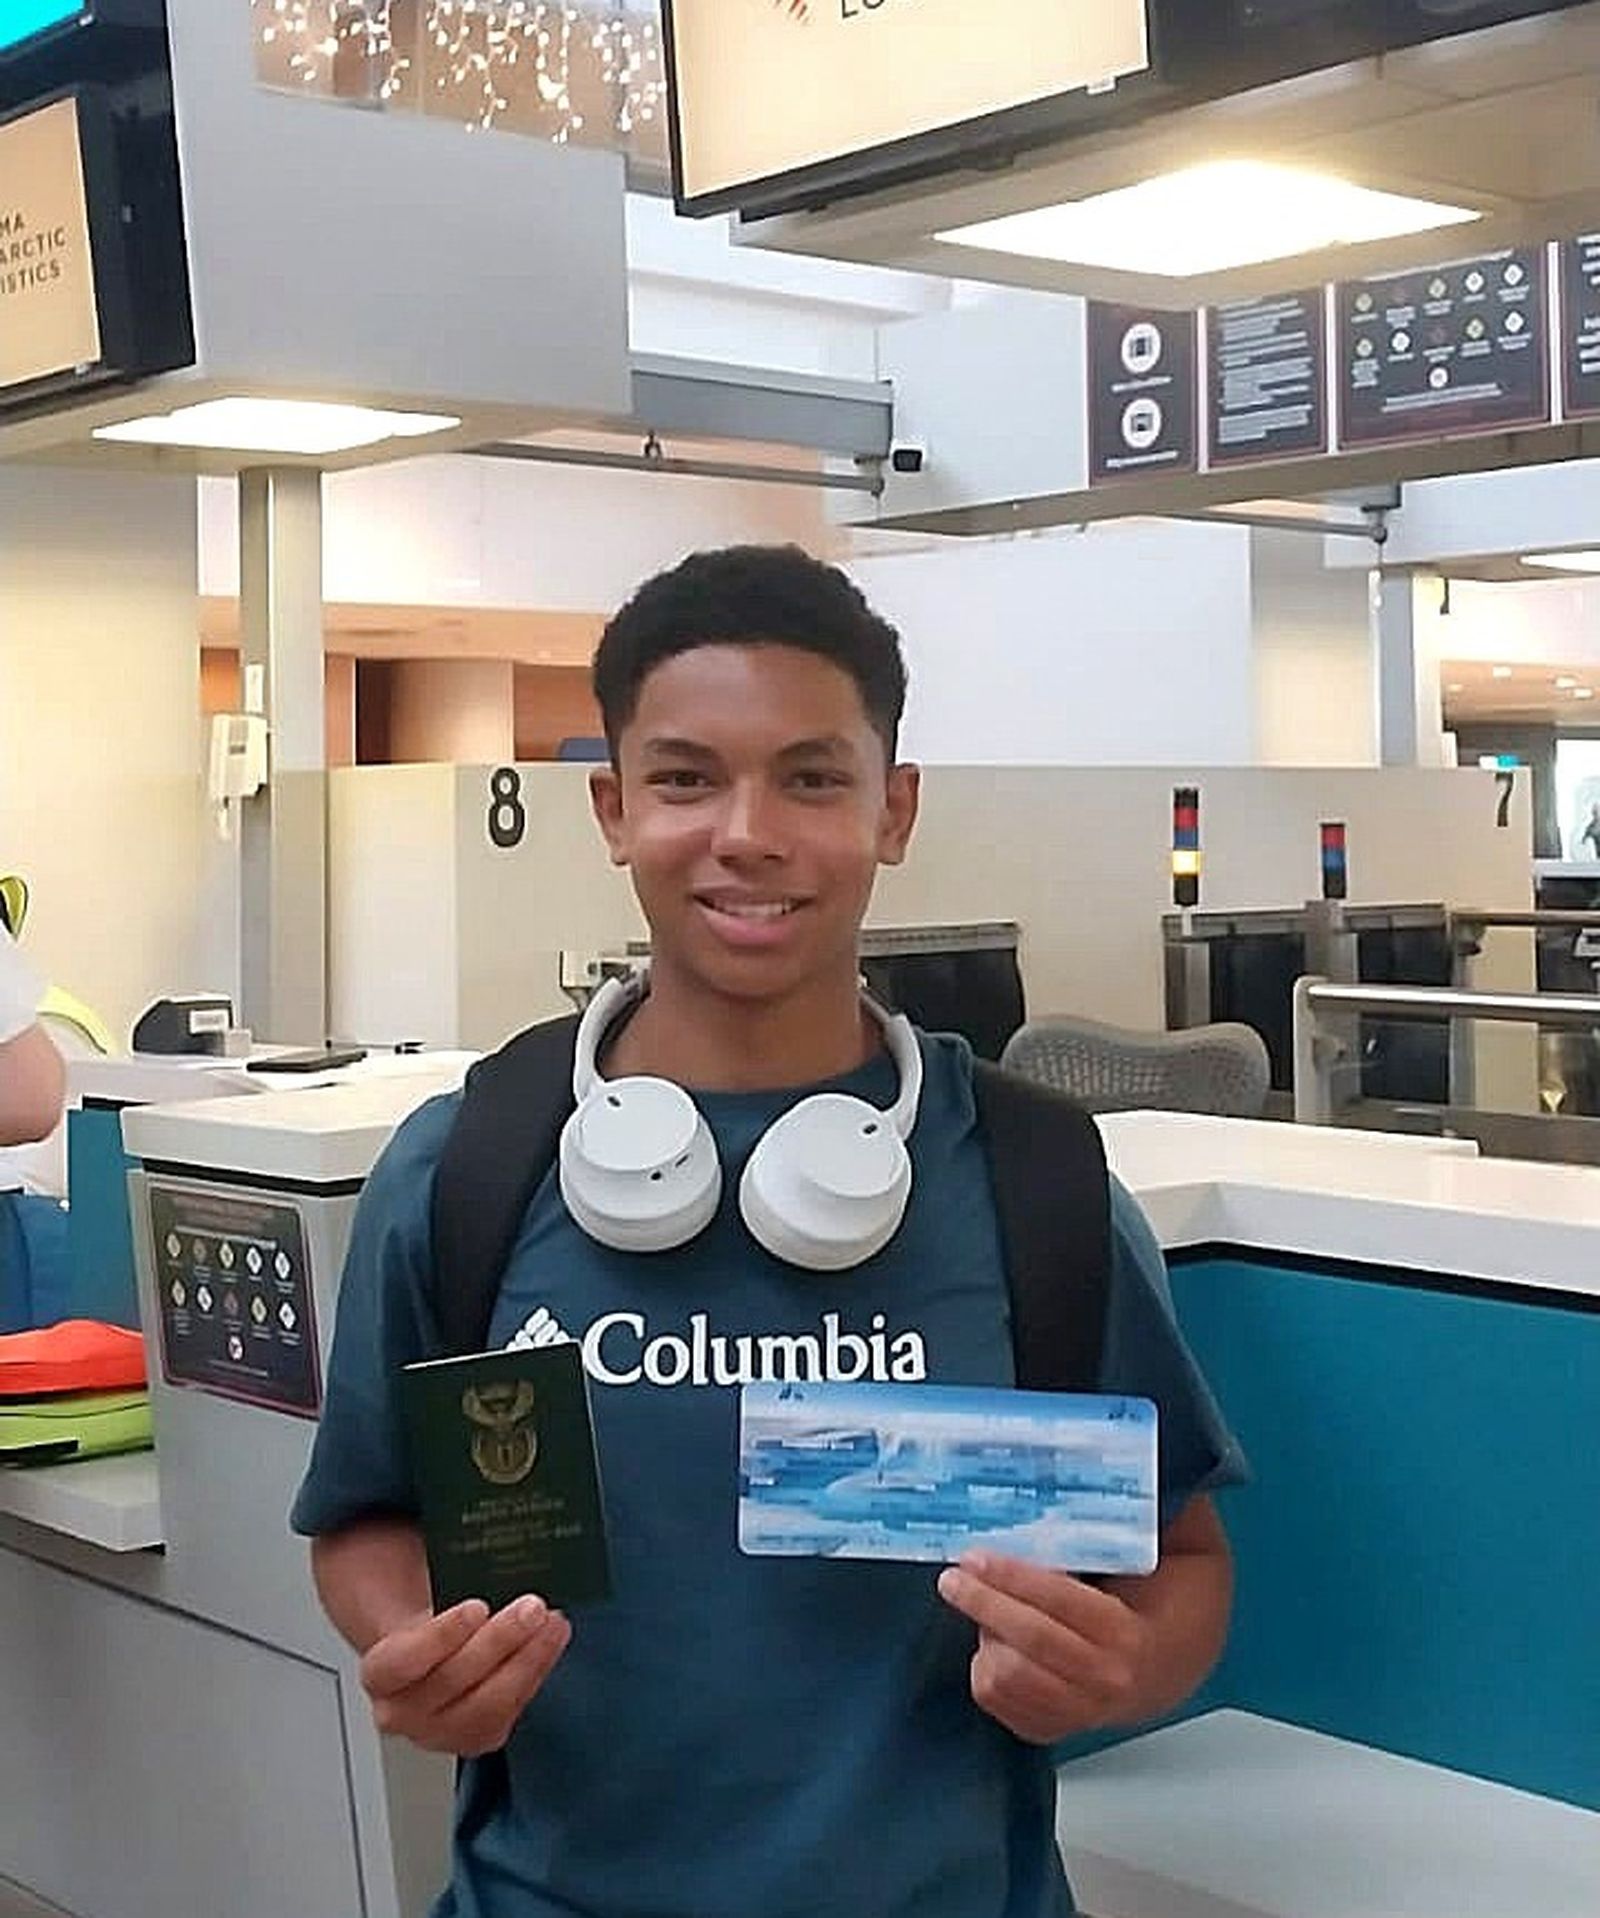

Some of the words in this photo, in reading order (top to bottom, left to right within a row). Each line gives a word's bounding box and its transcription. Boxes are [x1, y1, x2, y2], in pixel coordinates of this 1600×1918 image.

[488, 767, 525, 848] 8
[1495, 772, 1514, 828] 7
[582, 1311, 927, 1387] Columbia
